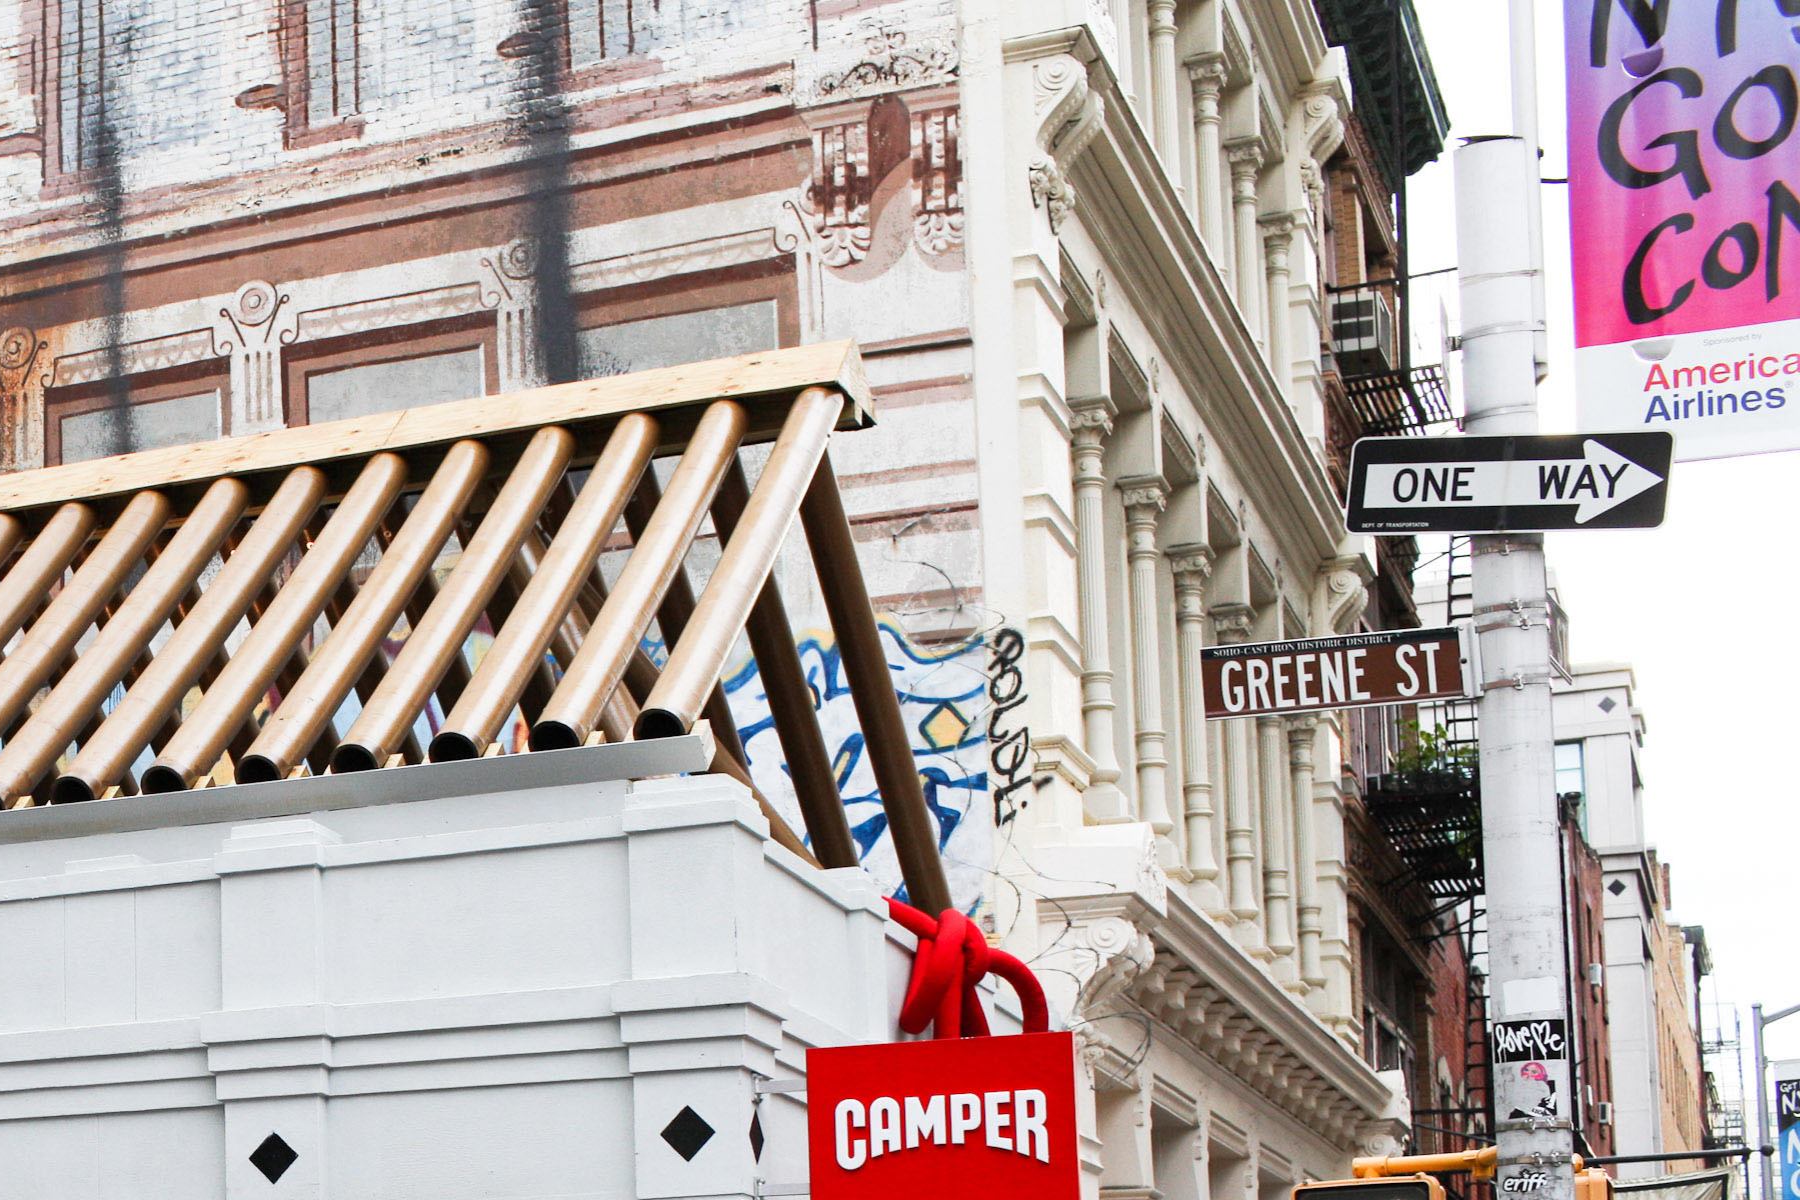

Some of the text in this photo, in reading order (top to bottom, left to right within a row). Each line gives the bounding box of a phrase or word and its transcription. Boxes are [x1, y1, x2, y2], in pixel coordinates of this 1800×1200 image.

[1703, 333, 1762, 346] Sponsored by
[1393, 463, 1630, 503] ONE WAY
[1271, 642, 1295, 653] IRON
[1297, 638, 1345, 651] HISTORIC
[1346, 635, 1393, 646] DISTRICT
[1220, 642, 1440, 713] GREENE ST
[834, 1088, 1050, 1171] CAMPER
